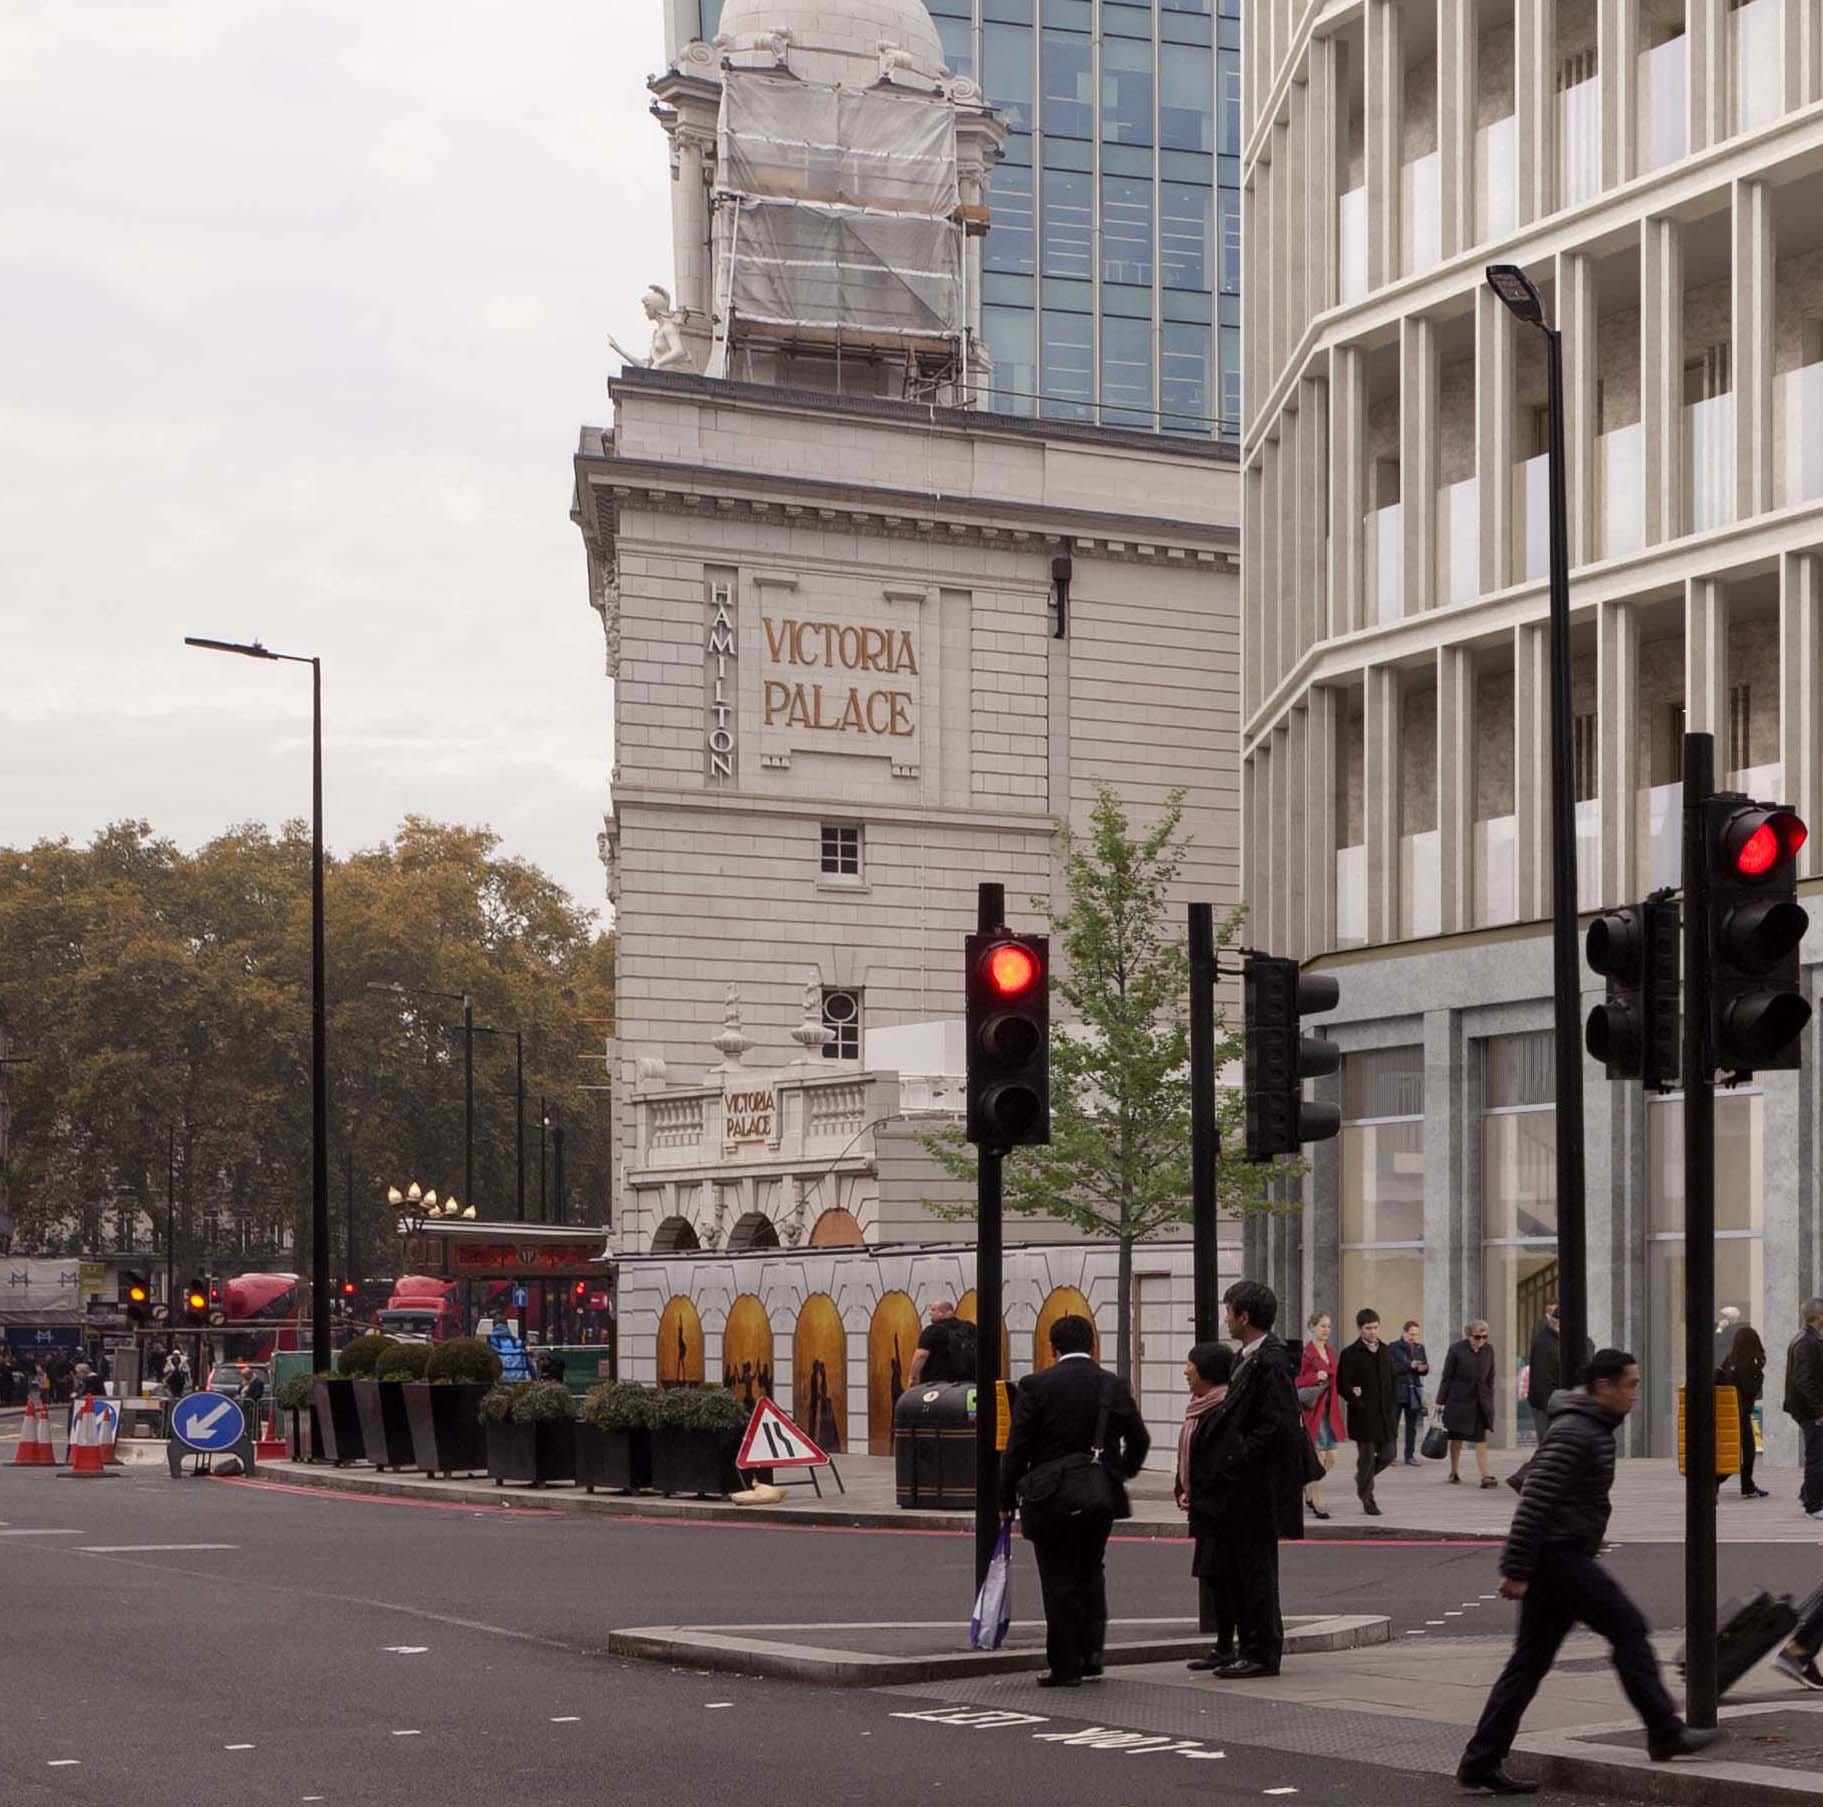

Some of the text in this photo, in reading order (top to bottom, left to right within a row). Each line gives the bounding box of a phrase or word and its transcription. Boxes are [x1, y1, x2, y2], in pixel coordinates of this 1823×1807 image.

[762, 617, 918, 675] VICTORIA
[708, 581, 736, 777] HAMILTON
[764, 680, 915, 736] PALACE
[725, 1091, 775, 1113] VICTORIA
[727, 1115, 771, 1138] PALACE
[889, 1706, 1204, 1753] LOOK LEFT
